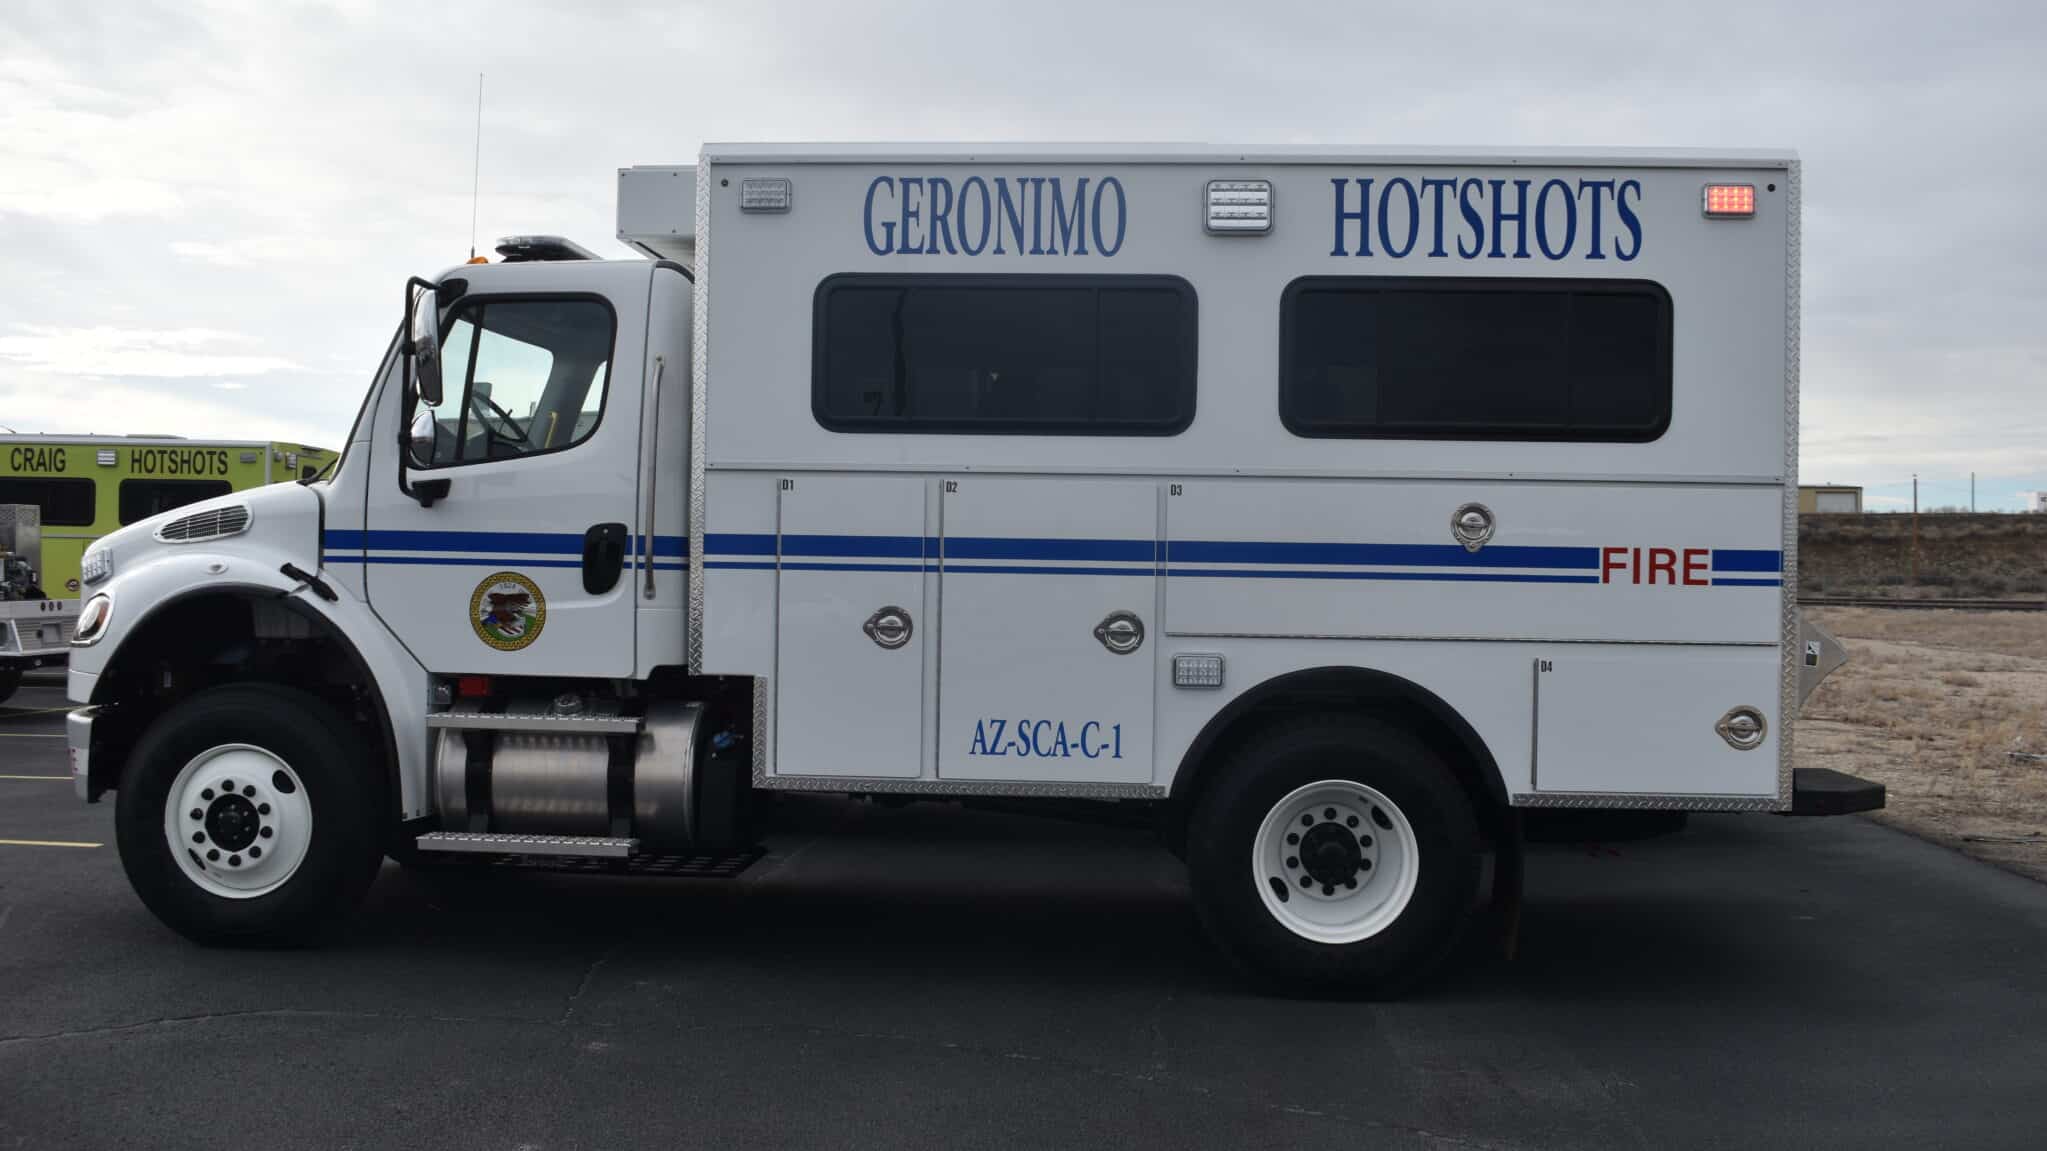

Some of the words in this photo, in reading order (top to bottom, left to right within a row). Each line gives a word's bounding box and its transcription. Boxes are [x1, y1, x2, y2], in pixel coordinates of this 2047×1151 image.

[863, 175, 1127, 257] GERONIMO
[1329, 176, 1643, 261] HOTSHOTS
[10, 448, 67, 472] CRAIG
[130, 449, 229, 475] HOTSHOTS
[1602, 547, 1709, 586] FIRE
[968, 719, 1123, 759] AZ-SCA-C-1
